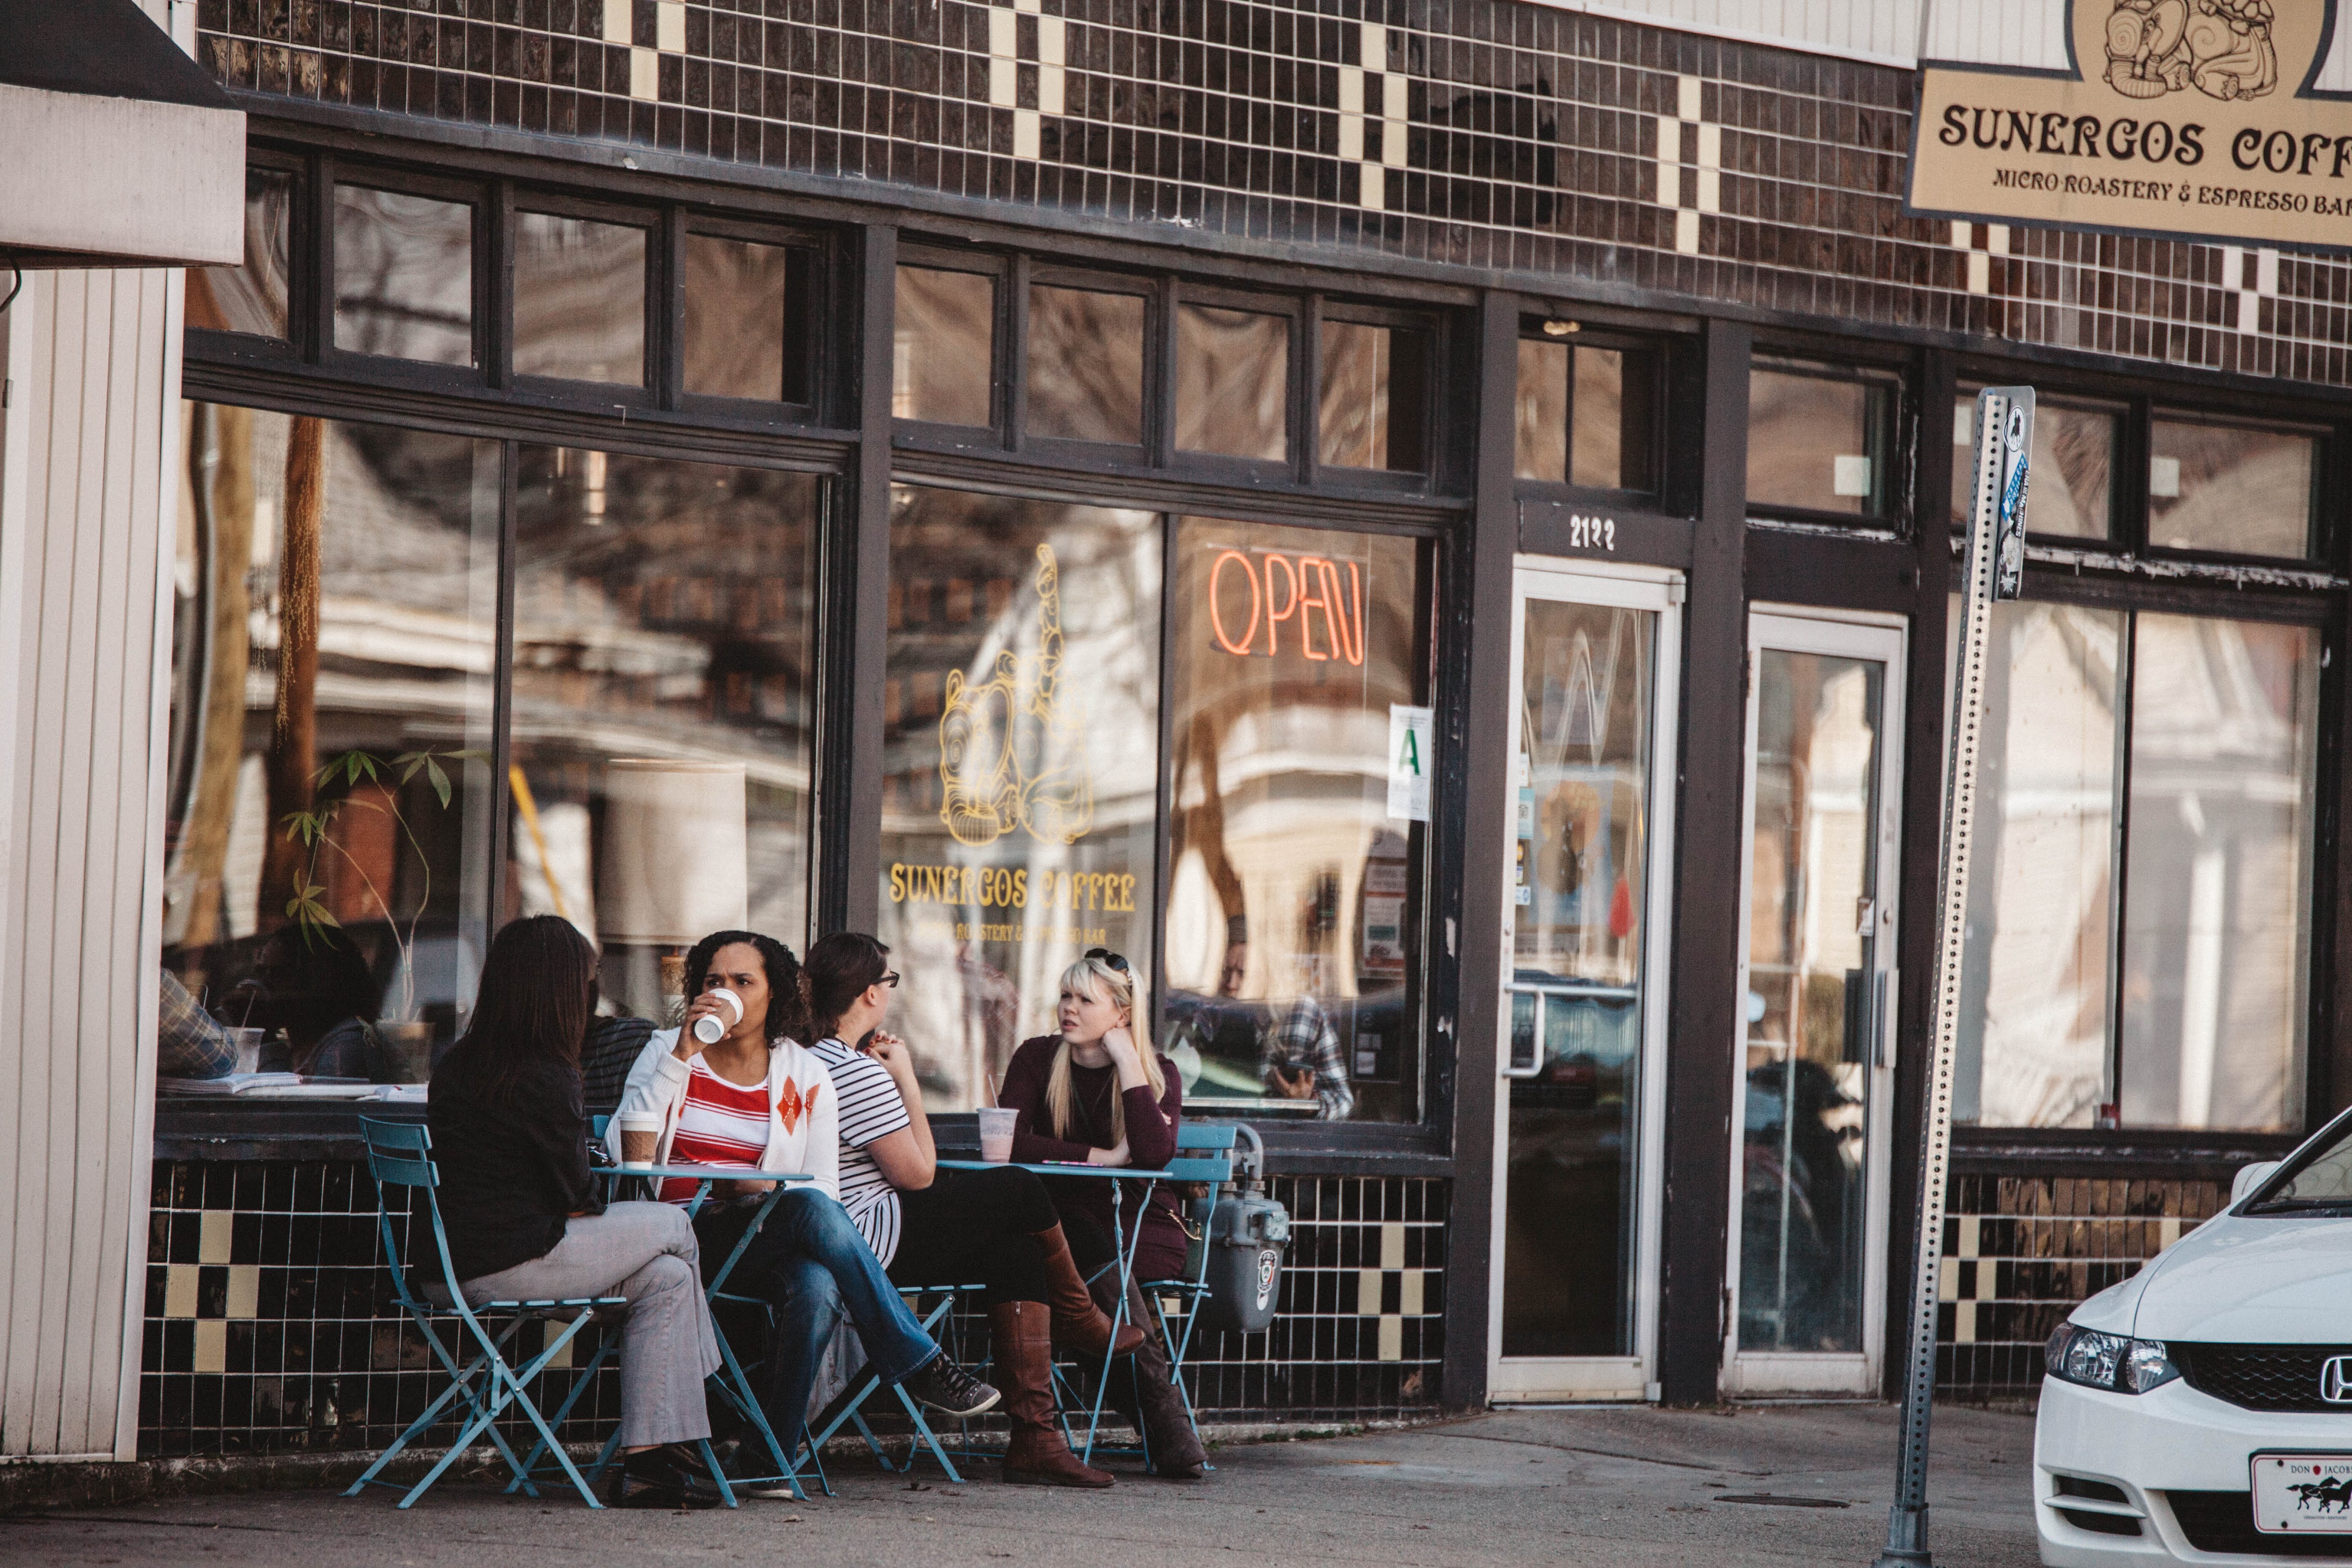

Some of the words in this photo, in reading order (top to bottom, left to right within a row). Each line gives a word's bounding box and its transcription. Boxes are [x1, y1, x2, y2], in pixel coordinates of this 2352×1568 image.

[1939, 104, 2206, 166] SUNERGOS
[1993, 168, 2059, 192] MICRO
[2064, 174, 2173, 201] ROASTERY
[2178, 179, 2191, 207] &
[2197, 185, 2308, 213] ESPRESSO
[1570, 514, 1615, 551] 2122
[1209, 550, 1363, 666] OPEN
[1398, 729, 1421, 776] A
[889, 863, 1028, 908] SUNERGOS
[1039, 871, 1136, 912] COFFEE
[2291, 1465, 2310, 1473] DON
[2325, 1465, 2352, 1475] JACOB
